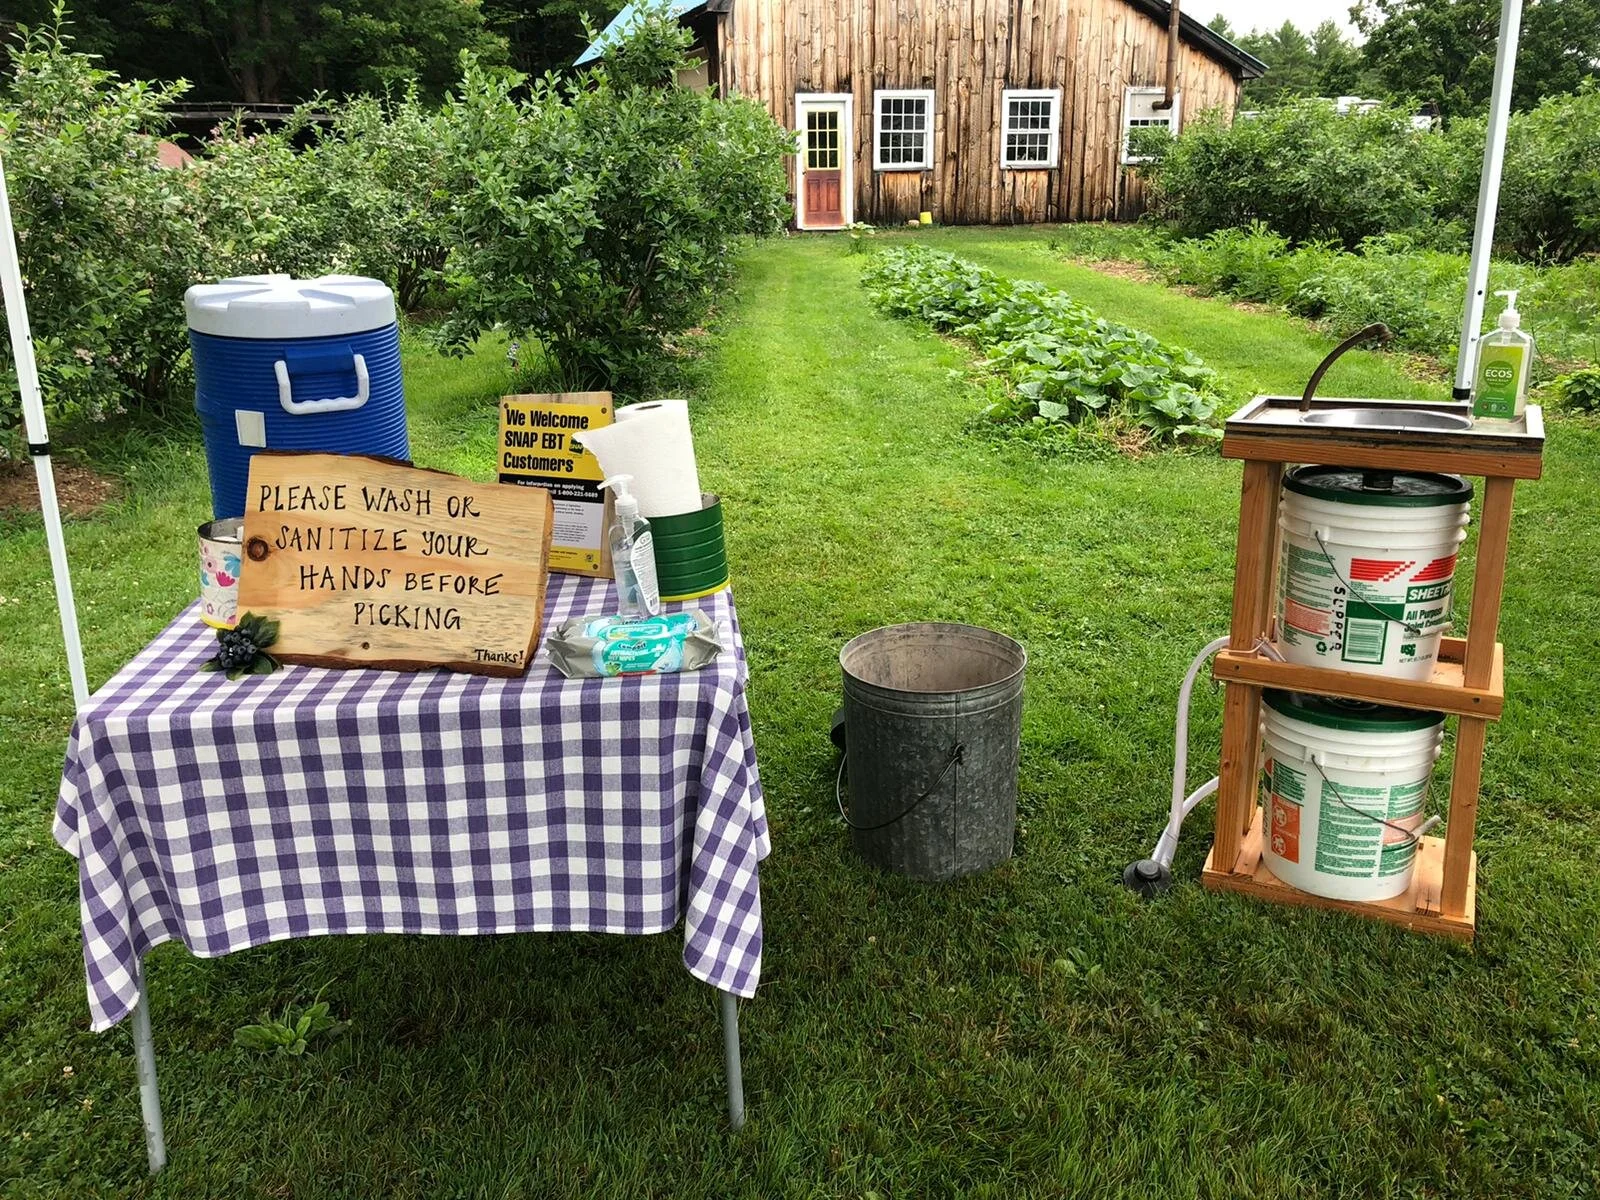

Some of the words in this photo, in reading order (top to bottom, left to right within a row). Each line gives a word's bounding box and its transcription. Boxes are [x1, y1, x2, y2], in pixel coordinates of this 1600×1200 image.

[1485, 369, 1512, 379] ECOS
[506, 408, 526, 427] We
[530, 410, 589, 430] Welcome
[504, 430, 539, 448] SNAP
[541, 432, 565, 450] EBT
[503, 451, 574, 473] Customers
[259, 484, 346, 512] PLEASE
[362, 486, 431, 516] WASH
[446, 495, 481, 518] OR
[275, 525, 408, 551] SANITIZE
[422, 530, 489, 557] YOUR
[299, 565, 391, 591] HANDS
[404, 573, 504, 596] BEFORE
[354, 602, 461, 631] PICKING
[1405, 610, 1418, 621] All
[474, 649, 525, 665] Thanks!
[1400, 644, 1416, 656] USG
